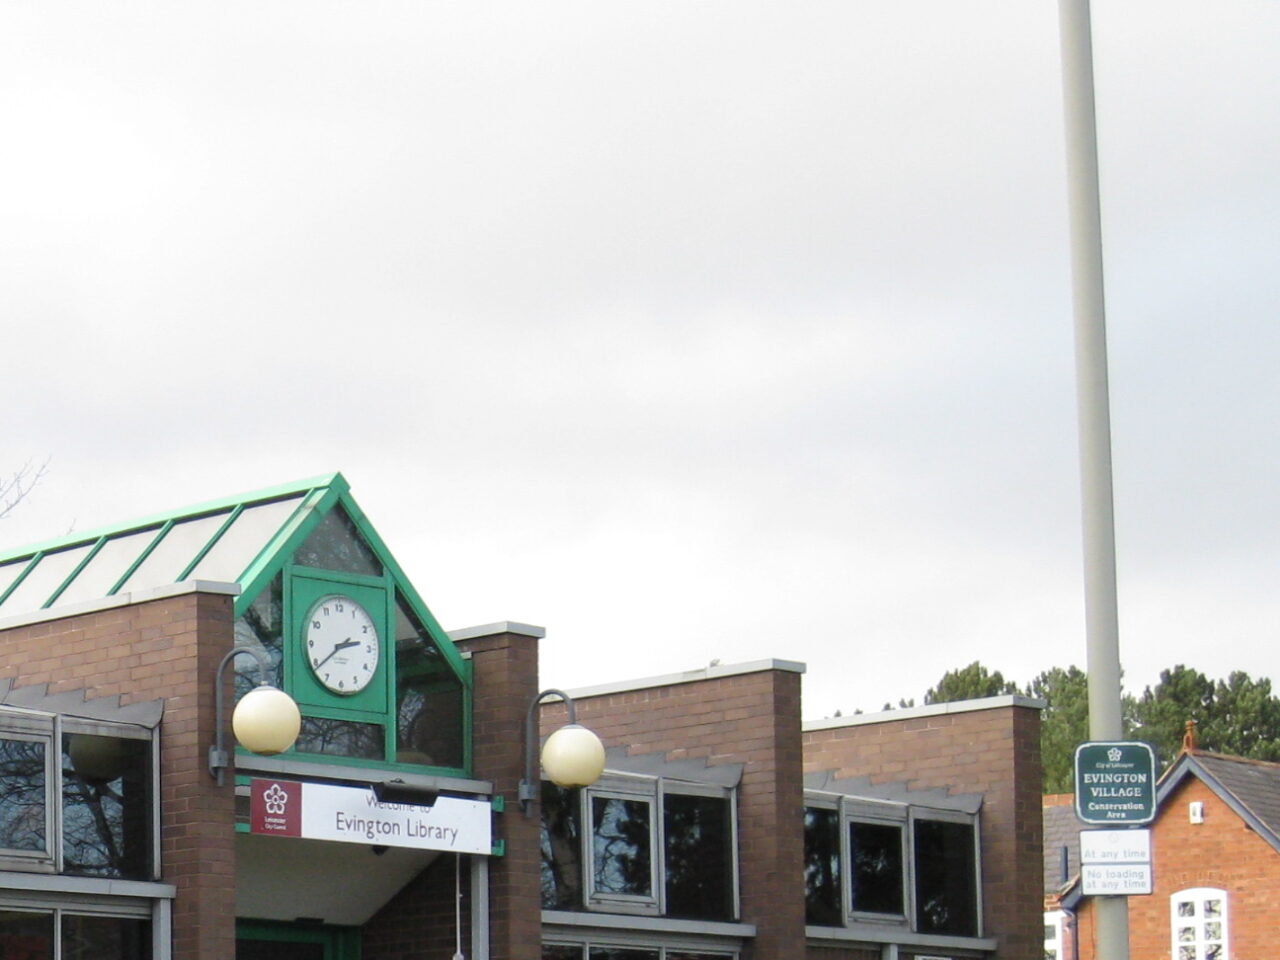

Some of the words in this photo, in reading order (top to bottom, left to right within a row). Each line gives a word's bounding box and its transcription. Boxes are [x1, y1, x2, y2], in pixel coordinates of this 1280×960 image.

[323, 607, 329, 616] 11
[335, 604, 344, 613] 12
[312, 621, 321, 629] 10
[362, 625, 368, 633] 2
[309, 640, 314, 648] 9
[366, 645, 371, 653] 3
[313, 658, 319, 666] 8
[363, 663, 368, 671] 4
[324, 673, 330, 681] 7
[353, 676, 358, 684] 5
[338, 680, 344, 688] 6
[1084, 773, 1147, 784] EVINGTON
[1090, 787, 1142, 797] VILLAGE
[1088, 802, 1144, 811] Conservation
[1106, 811, 1126, 819] Area
[336, 811, 401, 840] Evington
[407, 816, 459, 846] Library
[1084, 850, 1096, 858] At
[1101, 851, 1118, 860] any
[1123, 849, 1146, 858] time
[1087, 870, 1101, 879] No
[1106, 870, 1145, 880] loading
[1102, 882, 1119, 890] any
[1124, 880, 1146, 888] time
